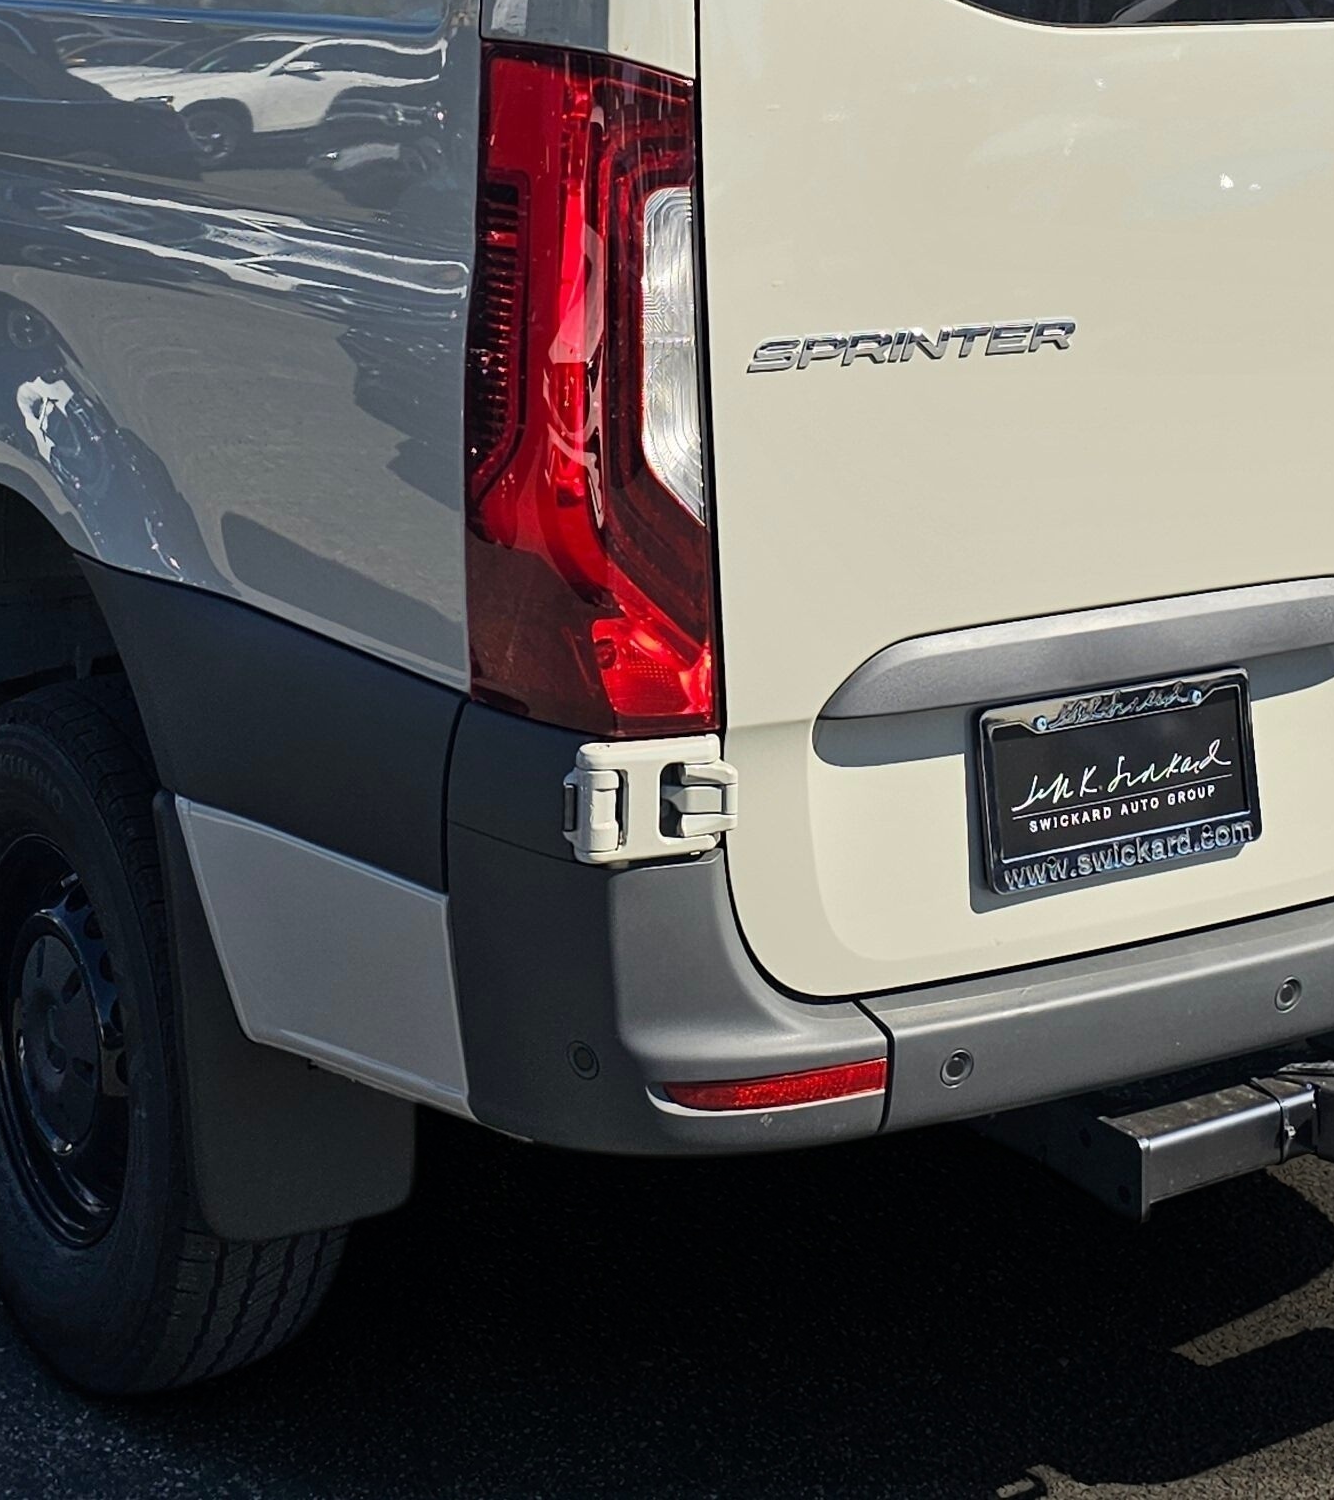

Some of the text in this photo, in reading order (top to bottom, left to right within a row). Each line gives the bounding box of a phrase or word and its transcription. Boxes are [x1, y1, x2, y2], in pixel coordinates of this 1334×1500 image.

[746, 318, 1076, 374] SPRINTER
[1028, 784, 1216, 834] SWICKARD AUTO GROUP
[1004, 820, 1255, 890] www.swickard.com
